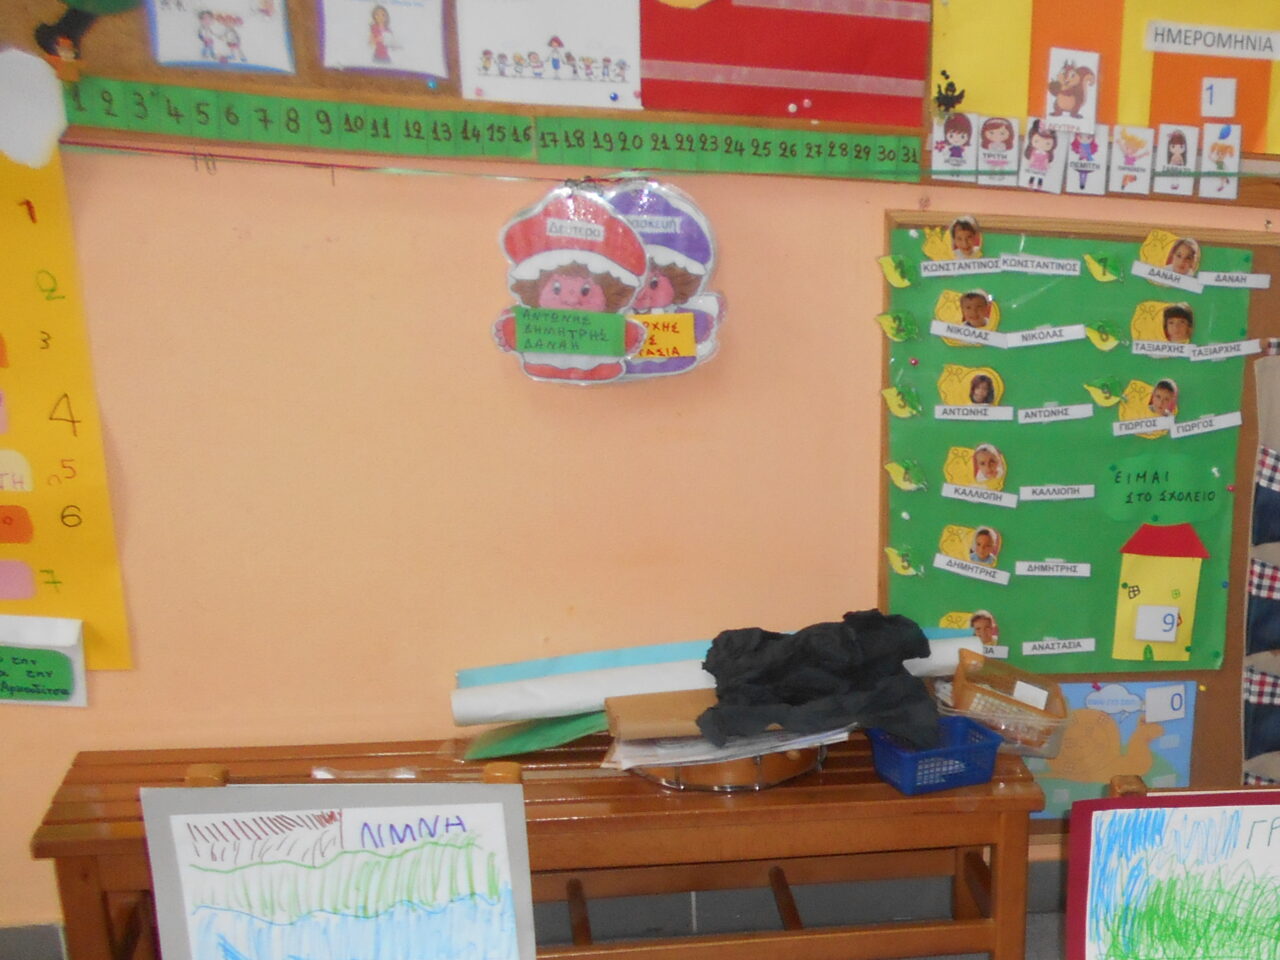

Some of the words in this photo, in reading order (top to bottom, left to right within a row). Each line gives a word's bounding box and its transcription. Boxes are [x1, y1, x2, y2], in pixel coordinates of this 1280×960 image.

[1153, 27, 1275, 53] ΗΜΕΡΟΜΗΝΙΑ
[1205, 84, 1214, 105] 1
[102, 90, 118, 117] 2
[133, 92, 148, 120] 3
[165, 96, 185, 124] 4
[196, 102, 210, 125] 5
[225, 105, 240, 126] 6
[254, 108, 273, 131] 7
[286, 107, 299, 133] 8
[316, 109, 332, 135] 9
[344, 112, 364, 133] 10
[371, 117, 391, 139] 11
[404, 119, 425, 140] 12
[432, 120, 452, 142] 13
[461, 119, 480, 142] 14
[487, 123, 506, 142] 15
[512, 125, 532, 142] 16
[540, 131, 559, 148] 17
[564, 129, 585, 148] 18
[593, 131, 614, 152] 19
[618, 131, 643, 151] 20
[651, 133, 671, 151] 21
[675, 133, 695, 152] 22
[699, 133, 719, 151] 23
[724, 136, 745, 156] 24
[751, 138, 772, 158] 25
[779, 141, 797, 158] 26
[805, 142, 823, 159] 27
[828, 141, 848, 157] 28
[854, 144, 872, 161] 29
[877, 145, 896, 161] 30
[902, 146, 918, 163] 31
[923, 259, 1000, 272] ΚΩΝΣΤΑΝΤΙΝΟΣ
[1002, 258, 1078, 272] ΚΩΝΣΤΑΝΤΙΝΟΣ
[1148, 268, 1181, 284] ΔΑΝΑΗ
[1215, 274, 1247, 284] ΔΑΝΑΗ
[40, 330, 51, 350] 3
[946, 325, 990, 341] ΝΙΚΟΛΑΣ
[1022, 329, 1064, 342] ΝΙΚΟΛΑΣ
[1135, 342, 1185, 354] ΤΑΞΙΑΡΧΗΣ
[1192, 344, 1241, 357] ΤΑΞΙΑΡΧΗΣ
[49, 393, 81, 437] 4
[942, 408, 989, 417] ΑΝΤΩΝΗΣ
[1024, 408, 1070, 419] ΑΝΤΩΝΗΣ
[1119, 419, 1158, 431] ΓΙΩΡΓΟΣ
[1177, 419, 1214, 434] ΓΙΩΡΓΟΣ
[60, 459, 77, 479] 5
[1114, 471, 1169, 484] ΕΙΜΑΙ
[954, 487, 1003, 502] ΚΑΛΛΙΟΠΗ
[1032, 487, 1080, 496] ΚΑΛΛΙΟΠΗ
[1126, 492, 1153, 504] ΣΤΟ
[1159, 490, 1216, 502] ΣΧΟΛΕΙΟ
[60, 505, 83, 527] 6
[946, 559, 998, 579] ΔΗΜΗΤΡΗΣ
[1027, 564, 1078, 574] ΔΗΜΗΤΡΗΣ
[39, 569, 63, 593] 7
[1162, 613, 1175, 633] 9
[1031, 641, 1082, 651] ΑΝΑΣΤΑΣΙΑ
